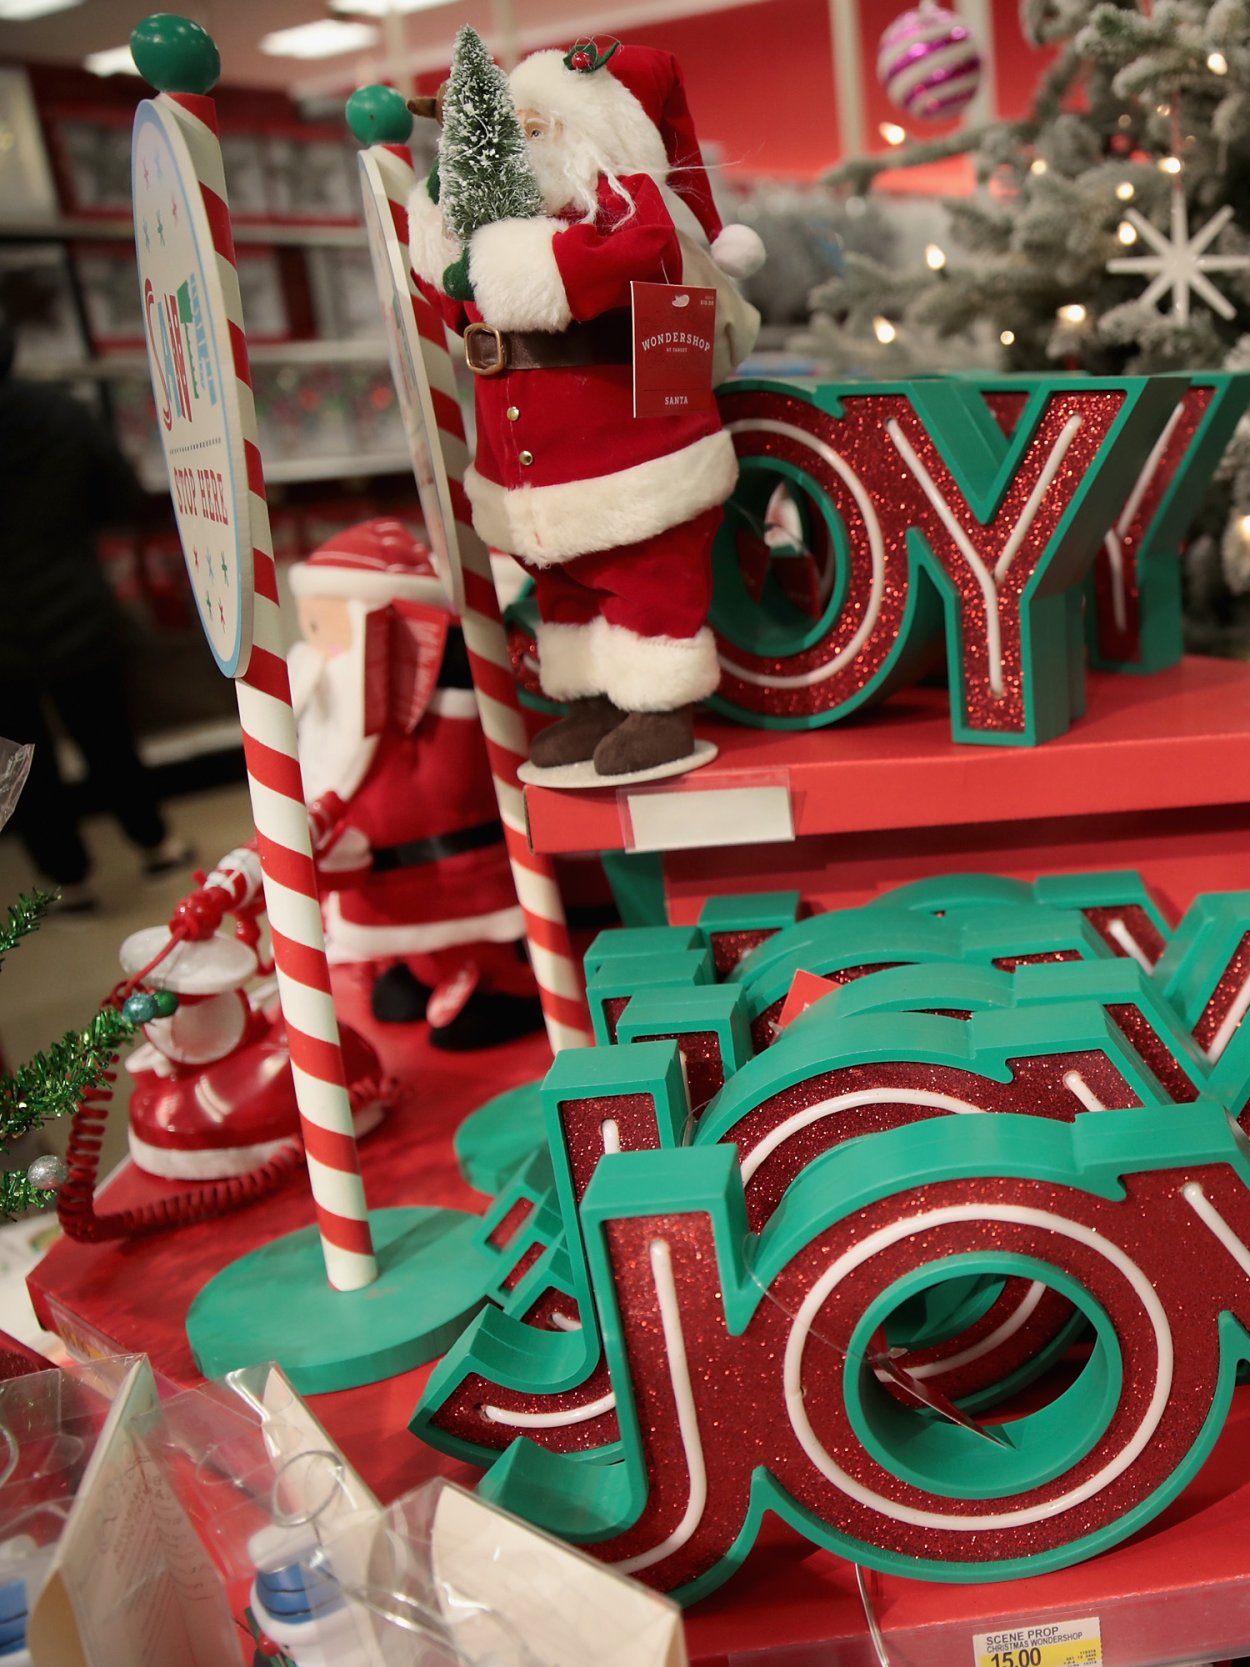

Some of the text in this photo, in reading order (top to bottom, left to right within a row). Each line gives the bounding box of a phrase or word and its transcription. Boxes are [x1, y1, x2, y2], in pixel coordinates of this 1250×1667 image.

[642, 332, 710, 351] WONDERSHOP
[664, 396, 688, 405] SANTA
[173, 467, 229, 525] STOP HERE
[701, 374, 1190, 747] OY
[986, 1626, 1059, 1646] SCENE PROP
[987, 1632, 1083, 1653] CHRISTMAS WONDERSHOP
[991, 1647, 1041, 1667] 15.00
